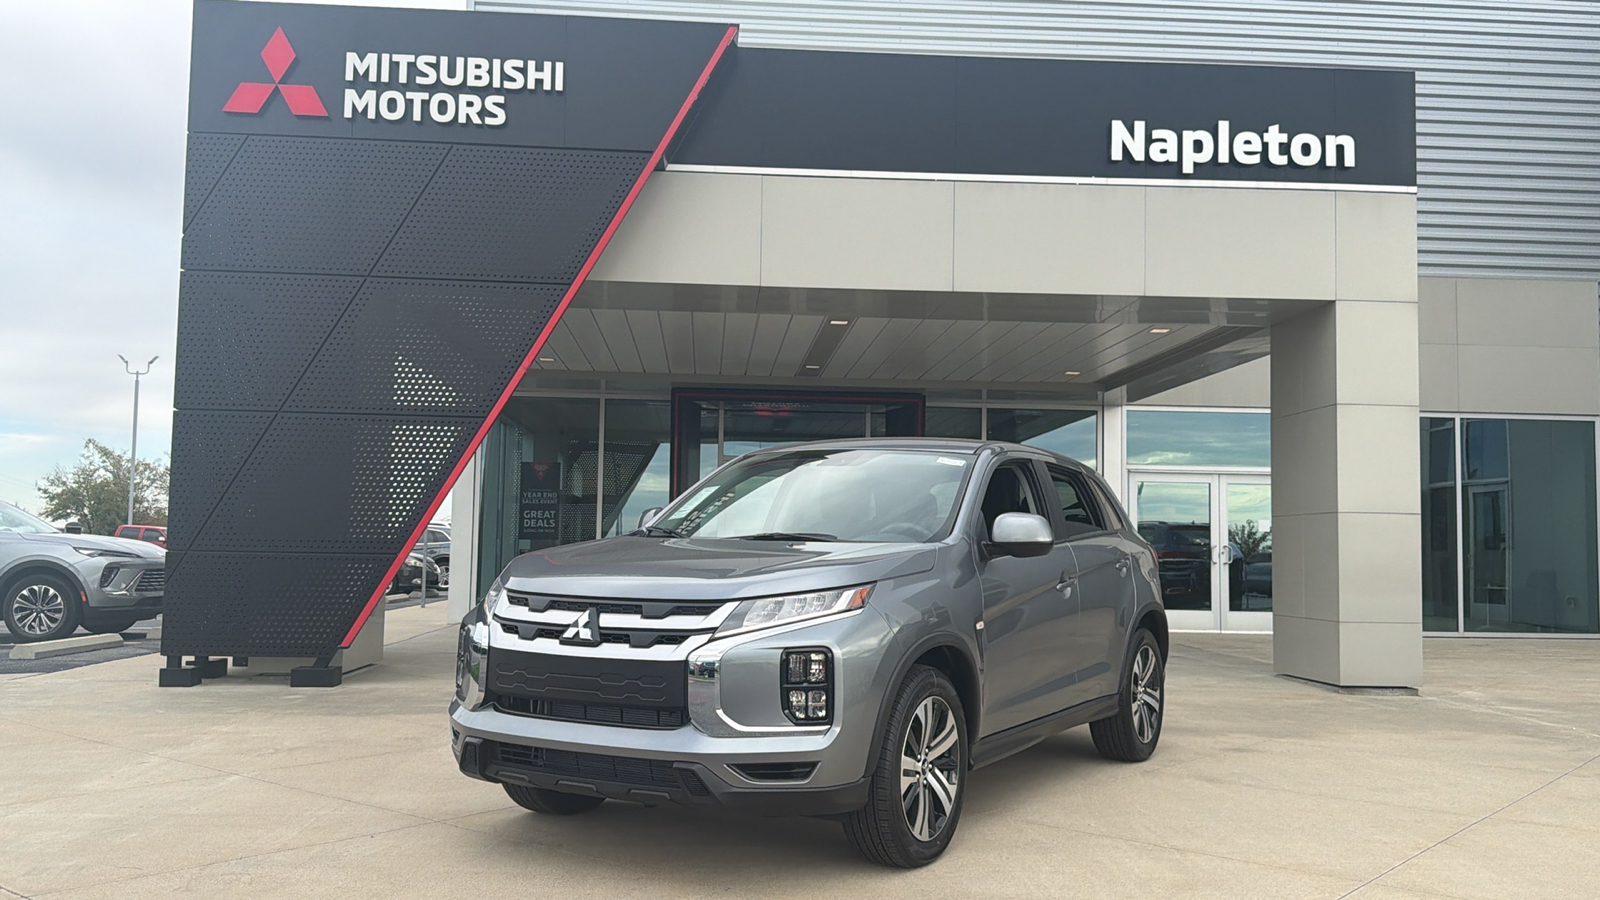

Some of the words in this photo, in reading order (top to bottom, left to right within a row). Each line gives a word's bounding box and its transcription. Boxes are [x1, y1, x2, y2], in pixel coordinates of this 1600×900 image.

[345, 52, 564, 91] MITSUBISHI
[344, 89, 507, 126] MOTORS
[1111, 120, 1356, 174] Napleton
[523, 510, 556, 519] GREAT
[523, 519, 556, 528] DEALS
